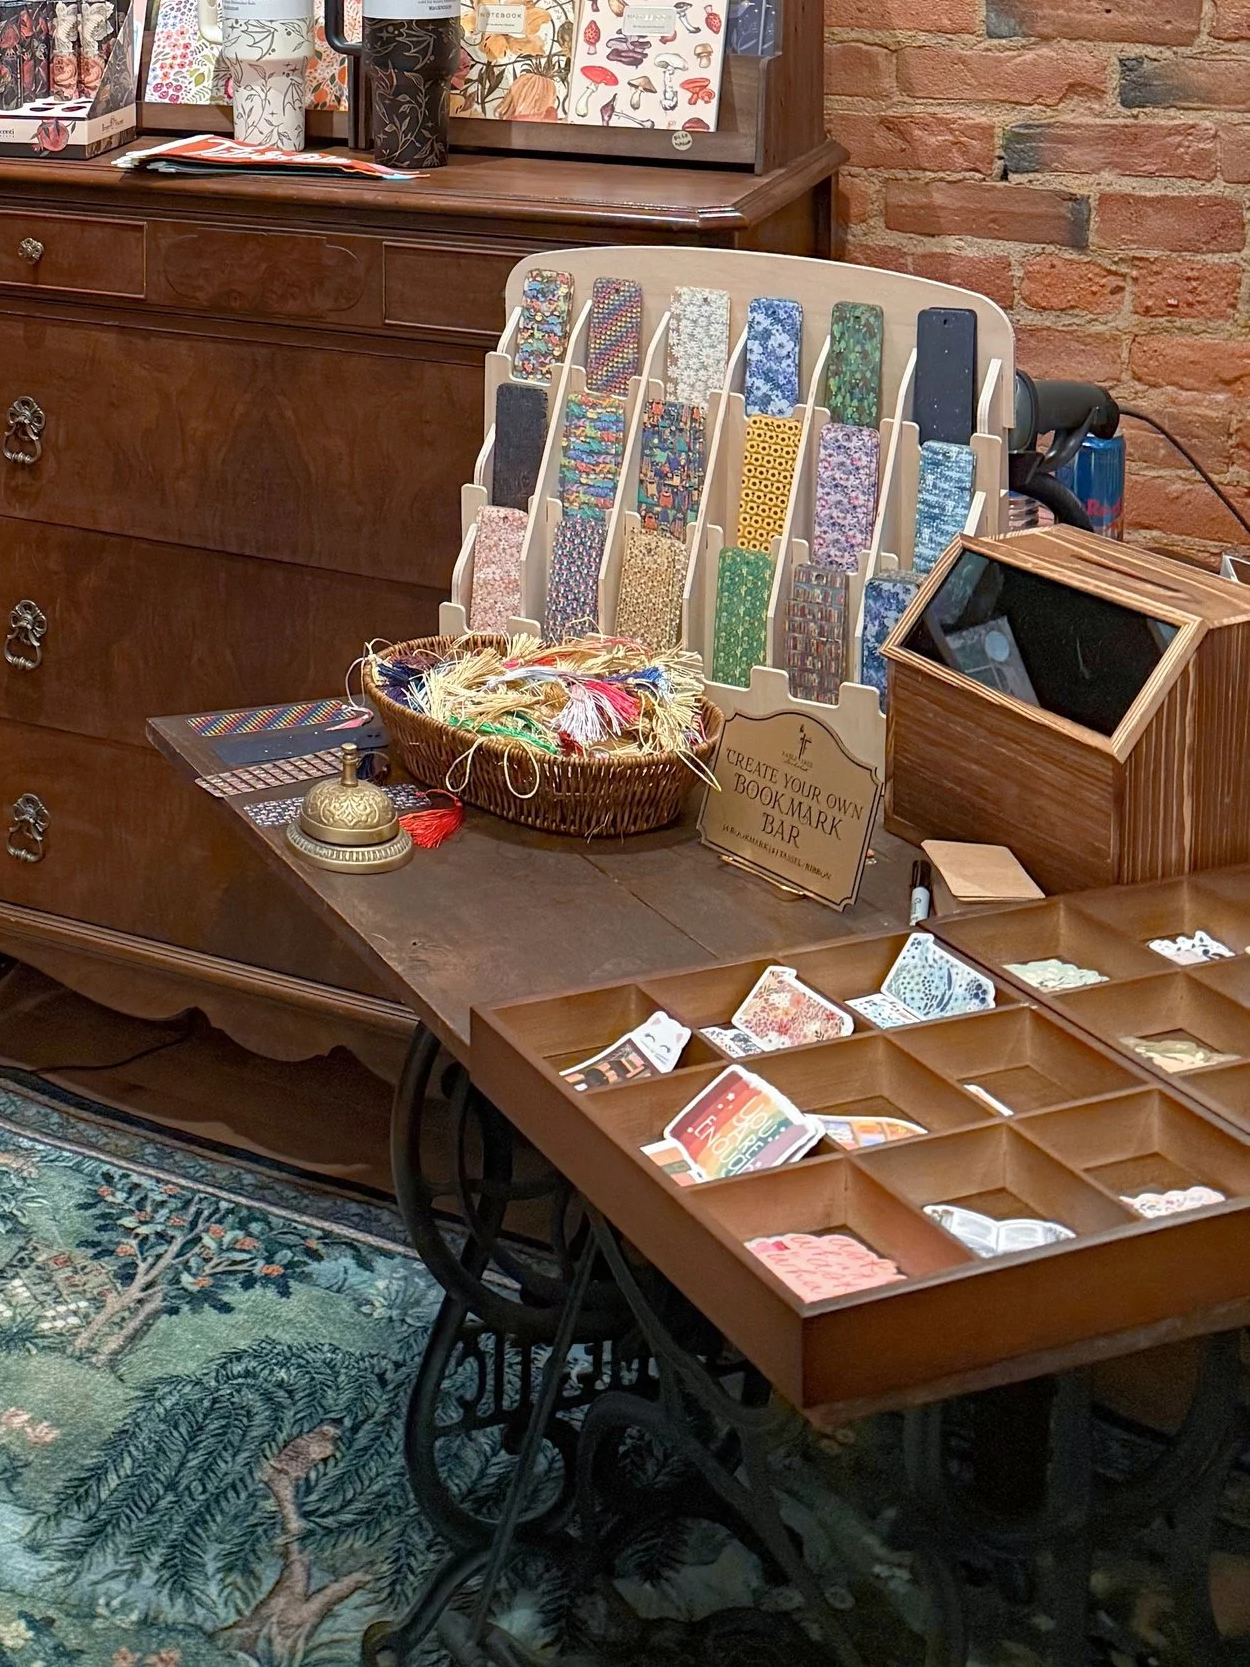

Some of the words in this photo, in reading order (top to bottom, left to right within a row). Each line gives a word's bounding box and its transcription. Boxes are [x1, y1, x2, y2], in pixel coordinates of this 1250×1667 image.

[479, 12, 522, 20] NOTEBOOK
[727, 748, 779, 783] CREATE
[784, 774, 821, 804] YOUR
[827, 794, 863, 820] OWN
[734, 772, 842, 840] BOOKMARK
[762, 812, 799, 848] BAR
[733, 1097, 777, 1136] YOU
[734, 1124, 764, 1159] ARE
